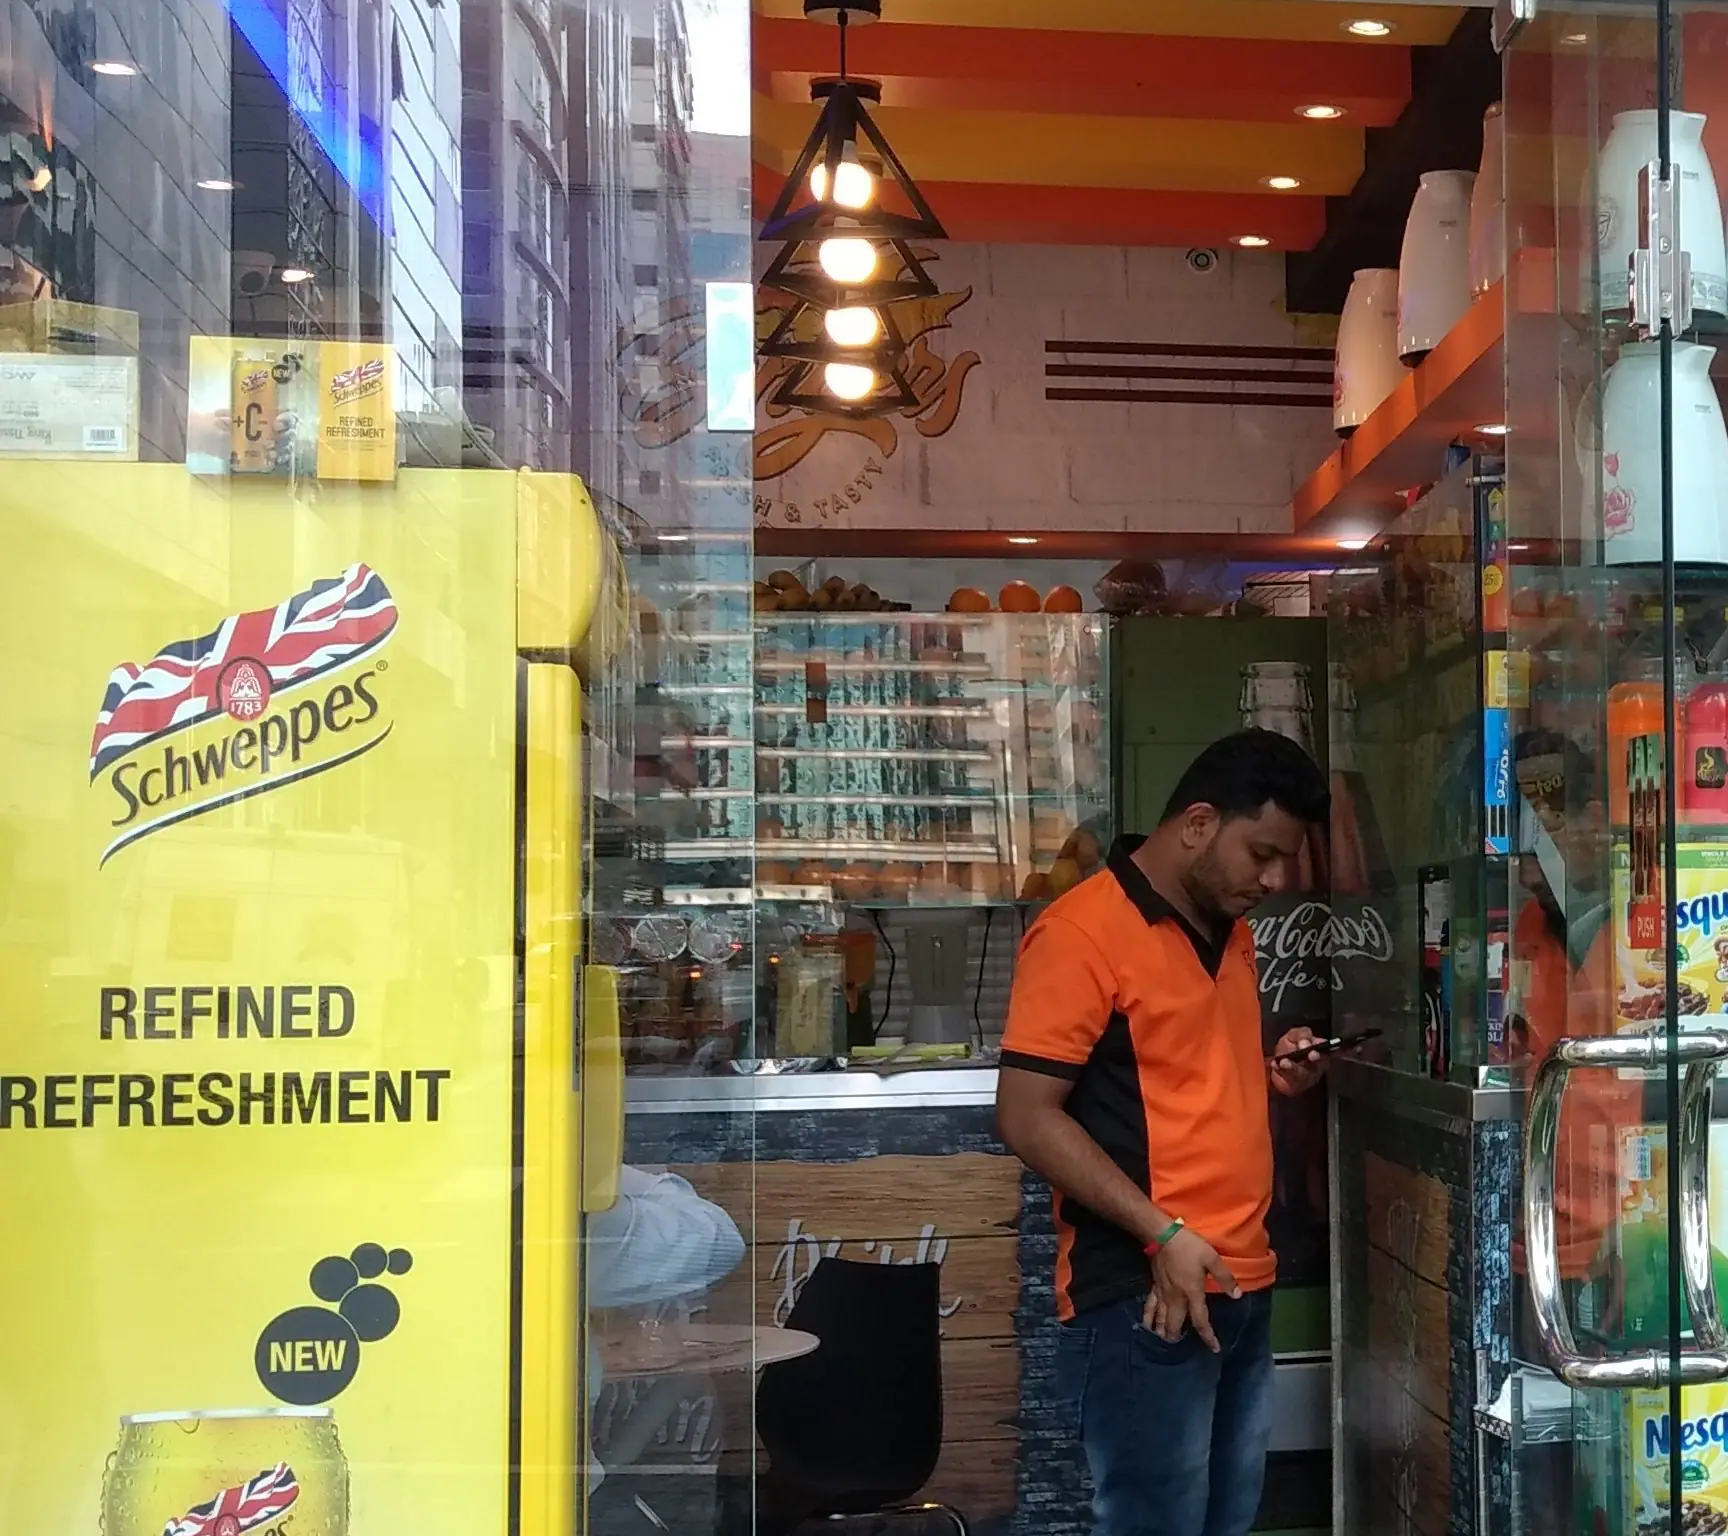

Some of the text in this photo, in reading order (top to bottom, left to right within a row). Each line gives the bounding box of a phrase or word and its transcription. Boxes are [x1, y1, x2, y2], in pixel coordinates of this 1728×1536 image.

[326, 427, 386, 440] REFRESHMENT
[339, 417, 374, 428] REFINED
[783, 502, 802, 523] &
[813, 456, 883, 520] TASTY
[1637, 916, 1656, 939] PUSH
[100, 985, 356, 1041] REFINED
[0, 1069, 451, 1129] REFRESHMENT
[268, 1338, 347, 1374] NEW
